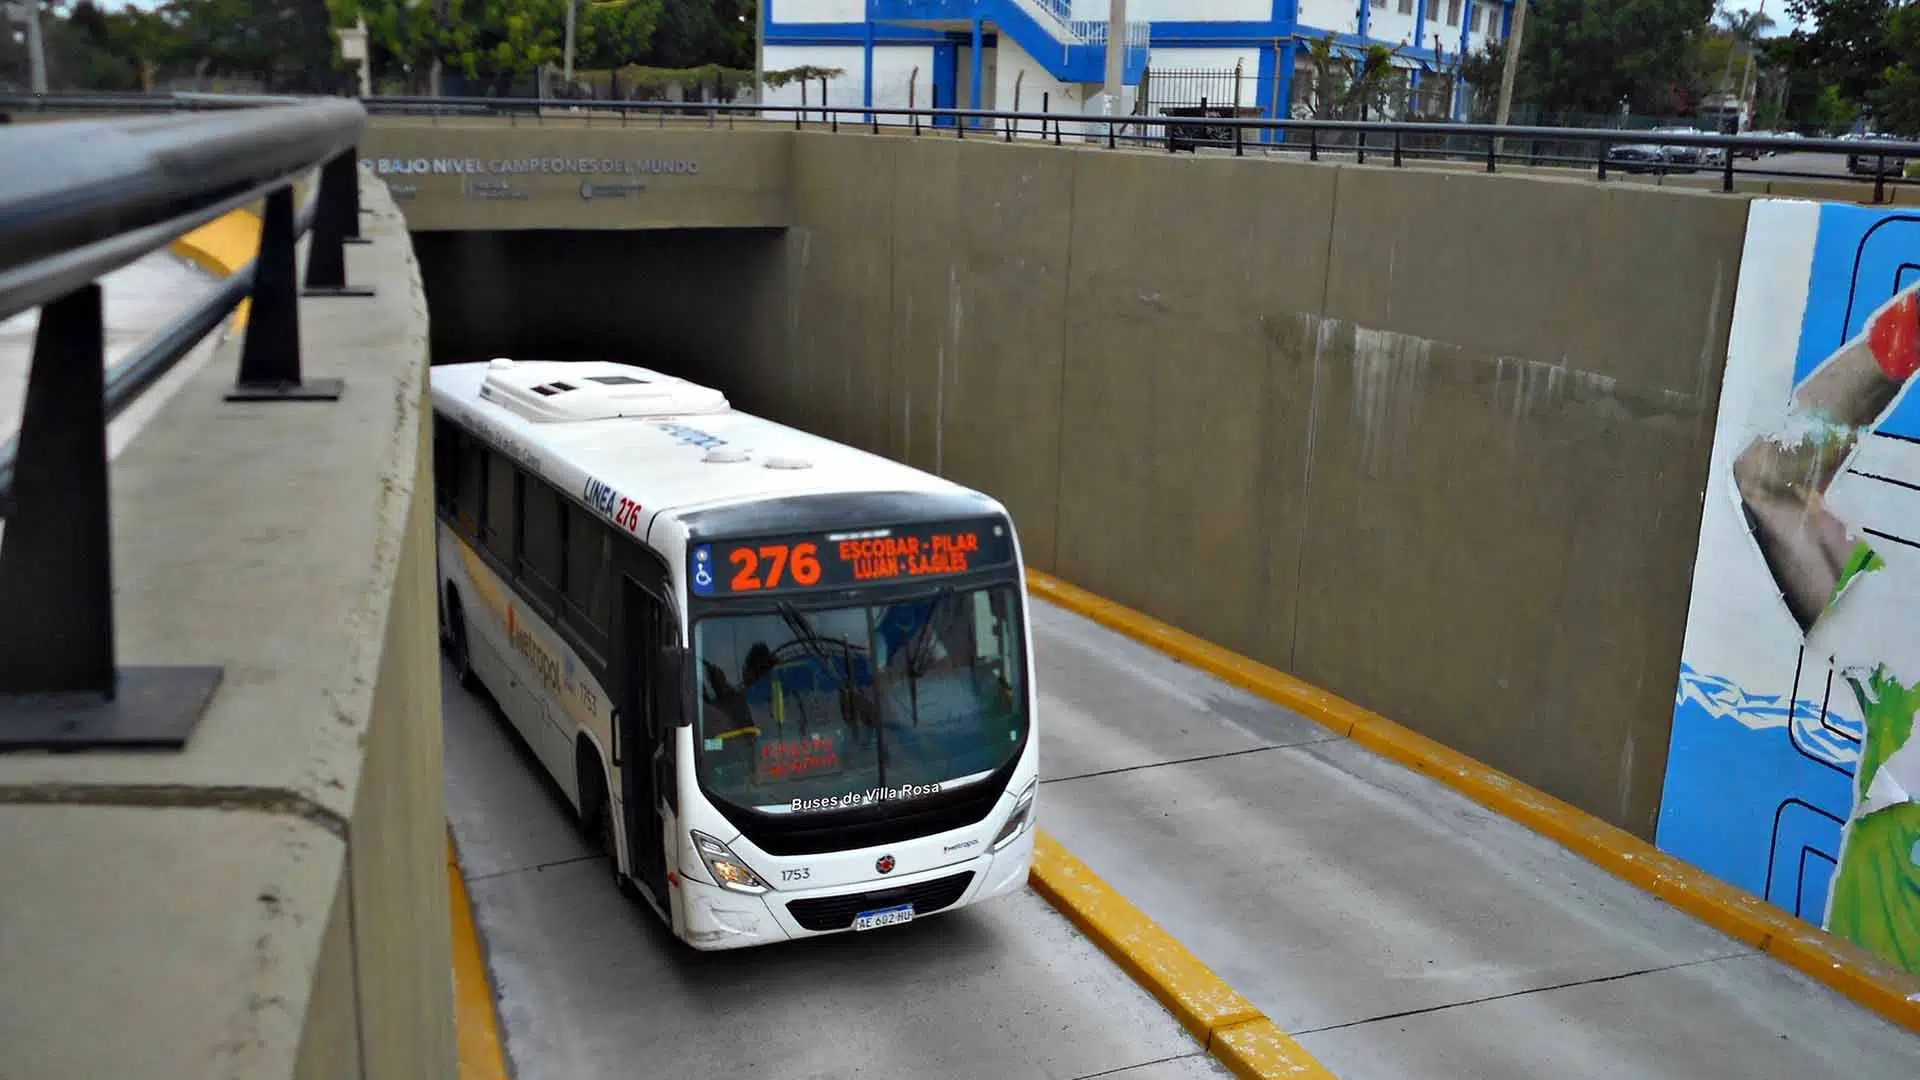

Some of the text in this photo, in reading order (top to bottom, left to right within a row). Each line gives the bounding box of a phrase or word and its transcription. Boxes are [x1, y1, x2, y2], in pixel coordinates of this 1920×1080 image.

[378, 159, 429, 174] BAJO
[432, 159, 485, 174] NIVEL
[488, 158, 598, 175] CAMPEONES
[600, 159, 631, 174] DEL
[638, 159, 699, 175] MUNDO
[584, 476, 642, 532] LINEA 276
[839, 537, 919, 560] ESCOBAR
[932, 534, 977, 556] PILAR
[729, 542, 822, 592] 276
[854, 555, 899, 579] LUJAN
[781, 867, 811, 881] 1753
[858, 916, 873, 929] AE
